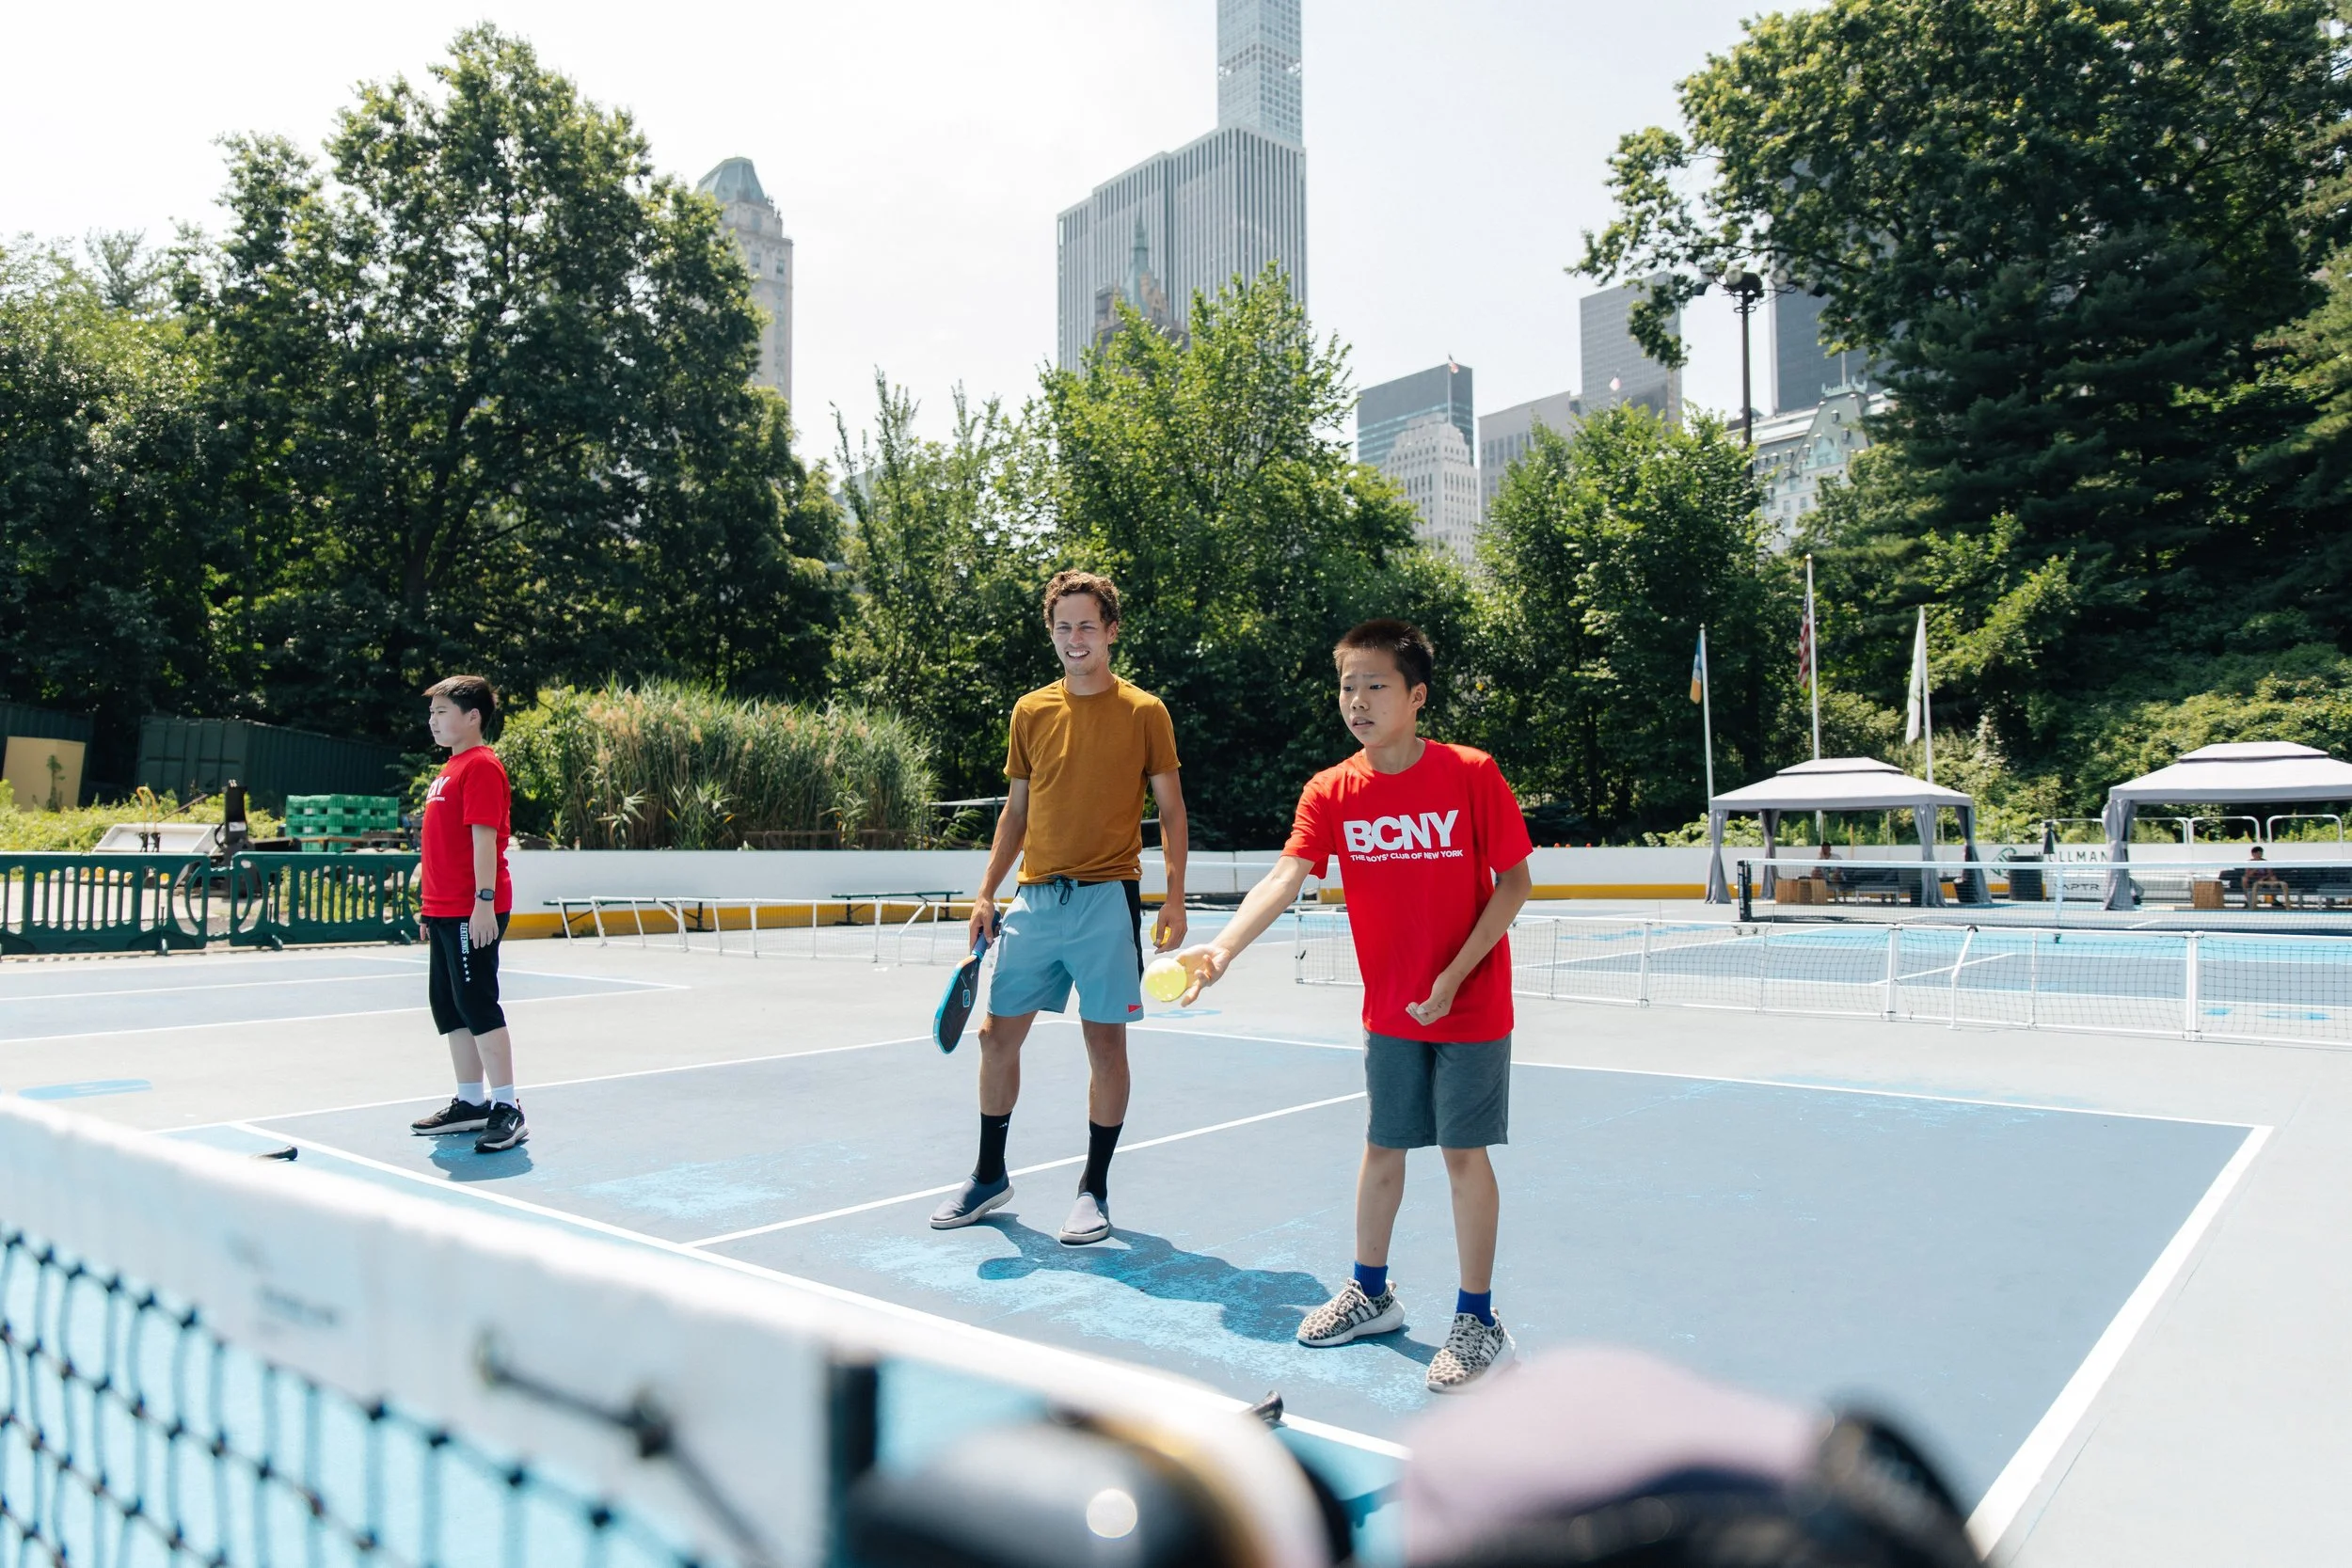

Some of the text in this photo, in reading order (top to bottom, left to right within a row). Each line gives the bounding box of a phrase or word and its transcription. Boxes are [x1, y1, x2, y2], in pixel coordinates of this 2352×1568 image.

[1343, 810, 1459, 853] BCNY
[1366, 853, 1389, 863] BOYS'
[1423, 851, 1439, 860] NEW
[1440, 849, 1463, 858] YORK
